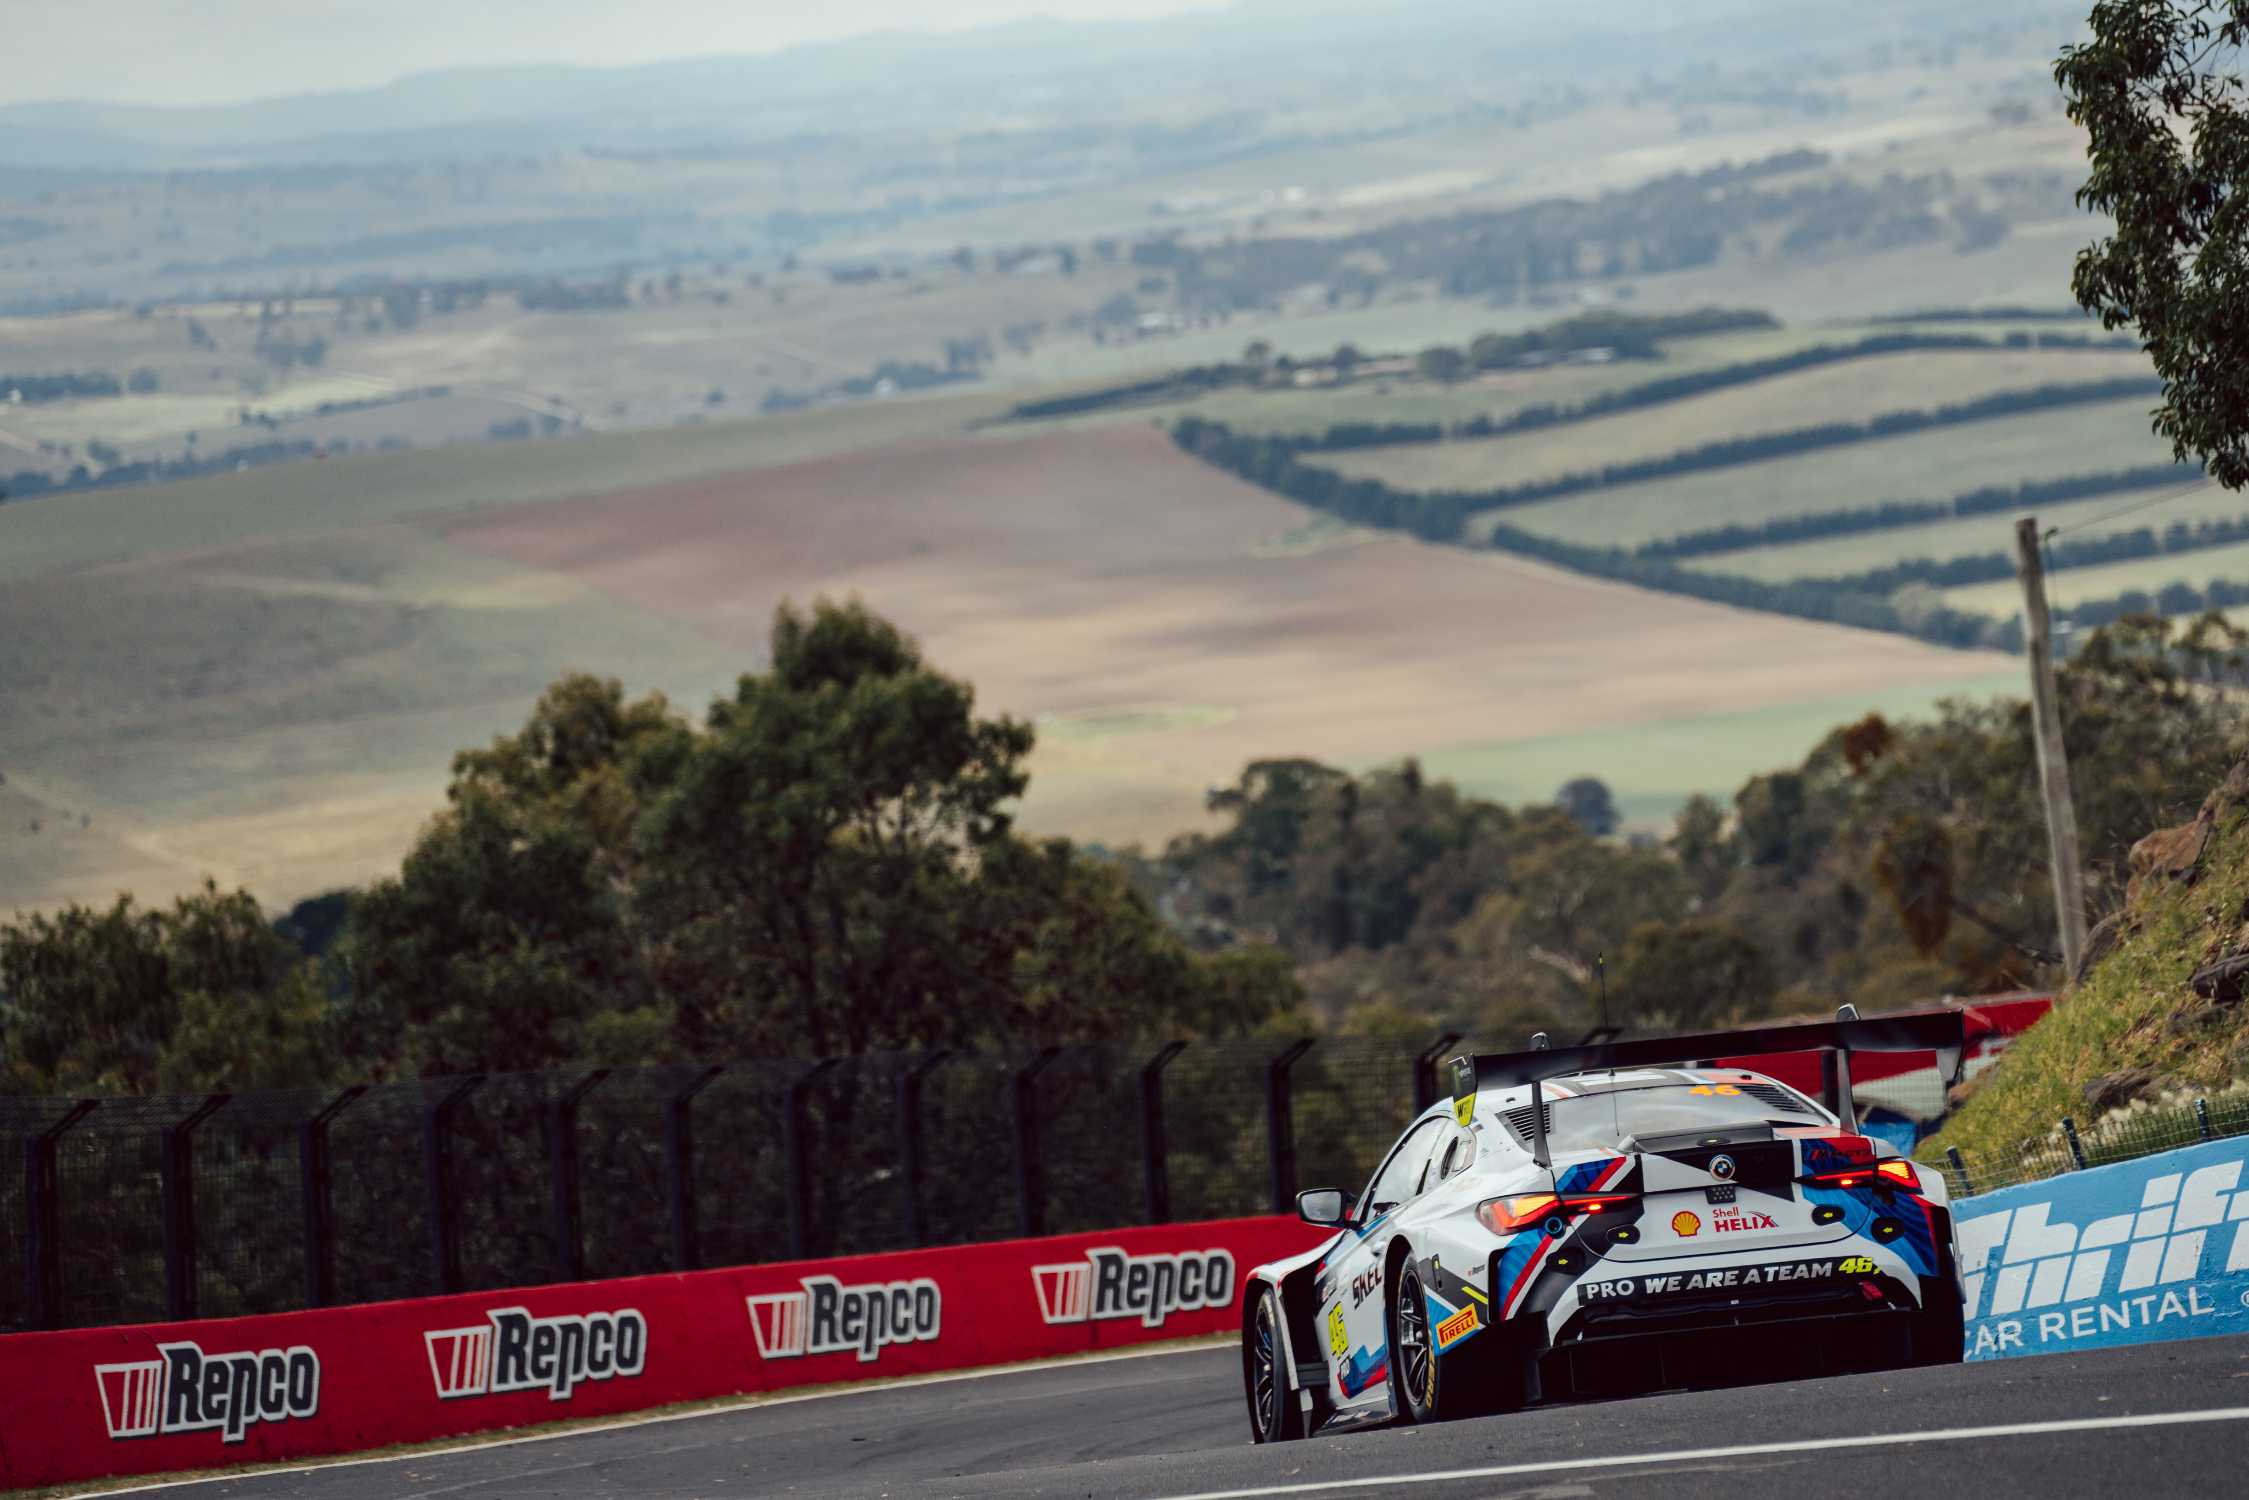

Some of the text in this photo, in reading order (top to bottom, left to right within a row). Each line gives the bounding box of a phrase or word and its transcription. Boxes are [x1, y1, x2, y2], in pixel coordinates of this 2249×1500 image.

[1689, 1085, 1741, 1097] 46
[1712, 1206, 1739, 1218] Shell
[1714, 1214, 1778, 1233] HELIX
[1089, 1249, 1232, 1324] Repco
[1586, 1279, 1635, 1300] PRO
[1645, 1275, 1683, 1295] WE
[1686, 1270, 1739, 1291] ARE
[1743, 1267, 1762, 1286] A
[1764, 1262, 1833, 1283] TEAM
[803, 1278, 939, 1359] Repco
[1439, 1310, 1475, 1345] PIRELLI
[2040, 1287, 2215, 1342] RENTAL
[491, 1309, 644, 1397] Repco
[160, 1344, 318, 1439] Repco
